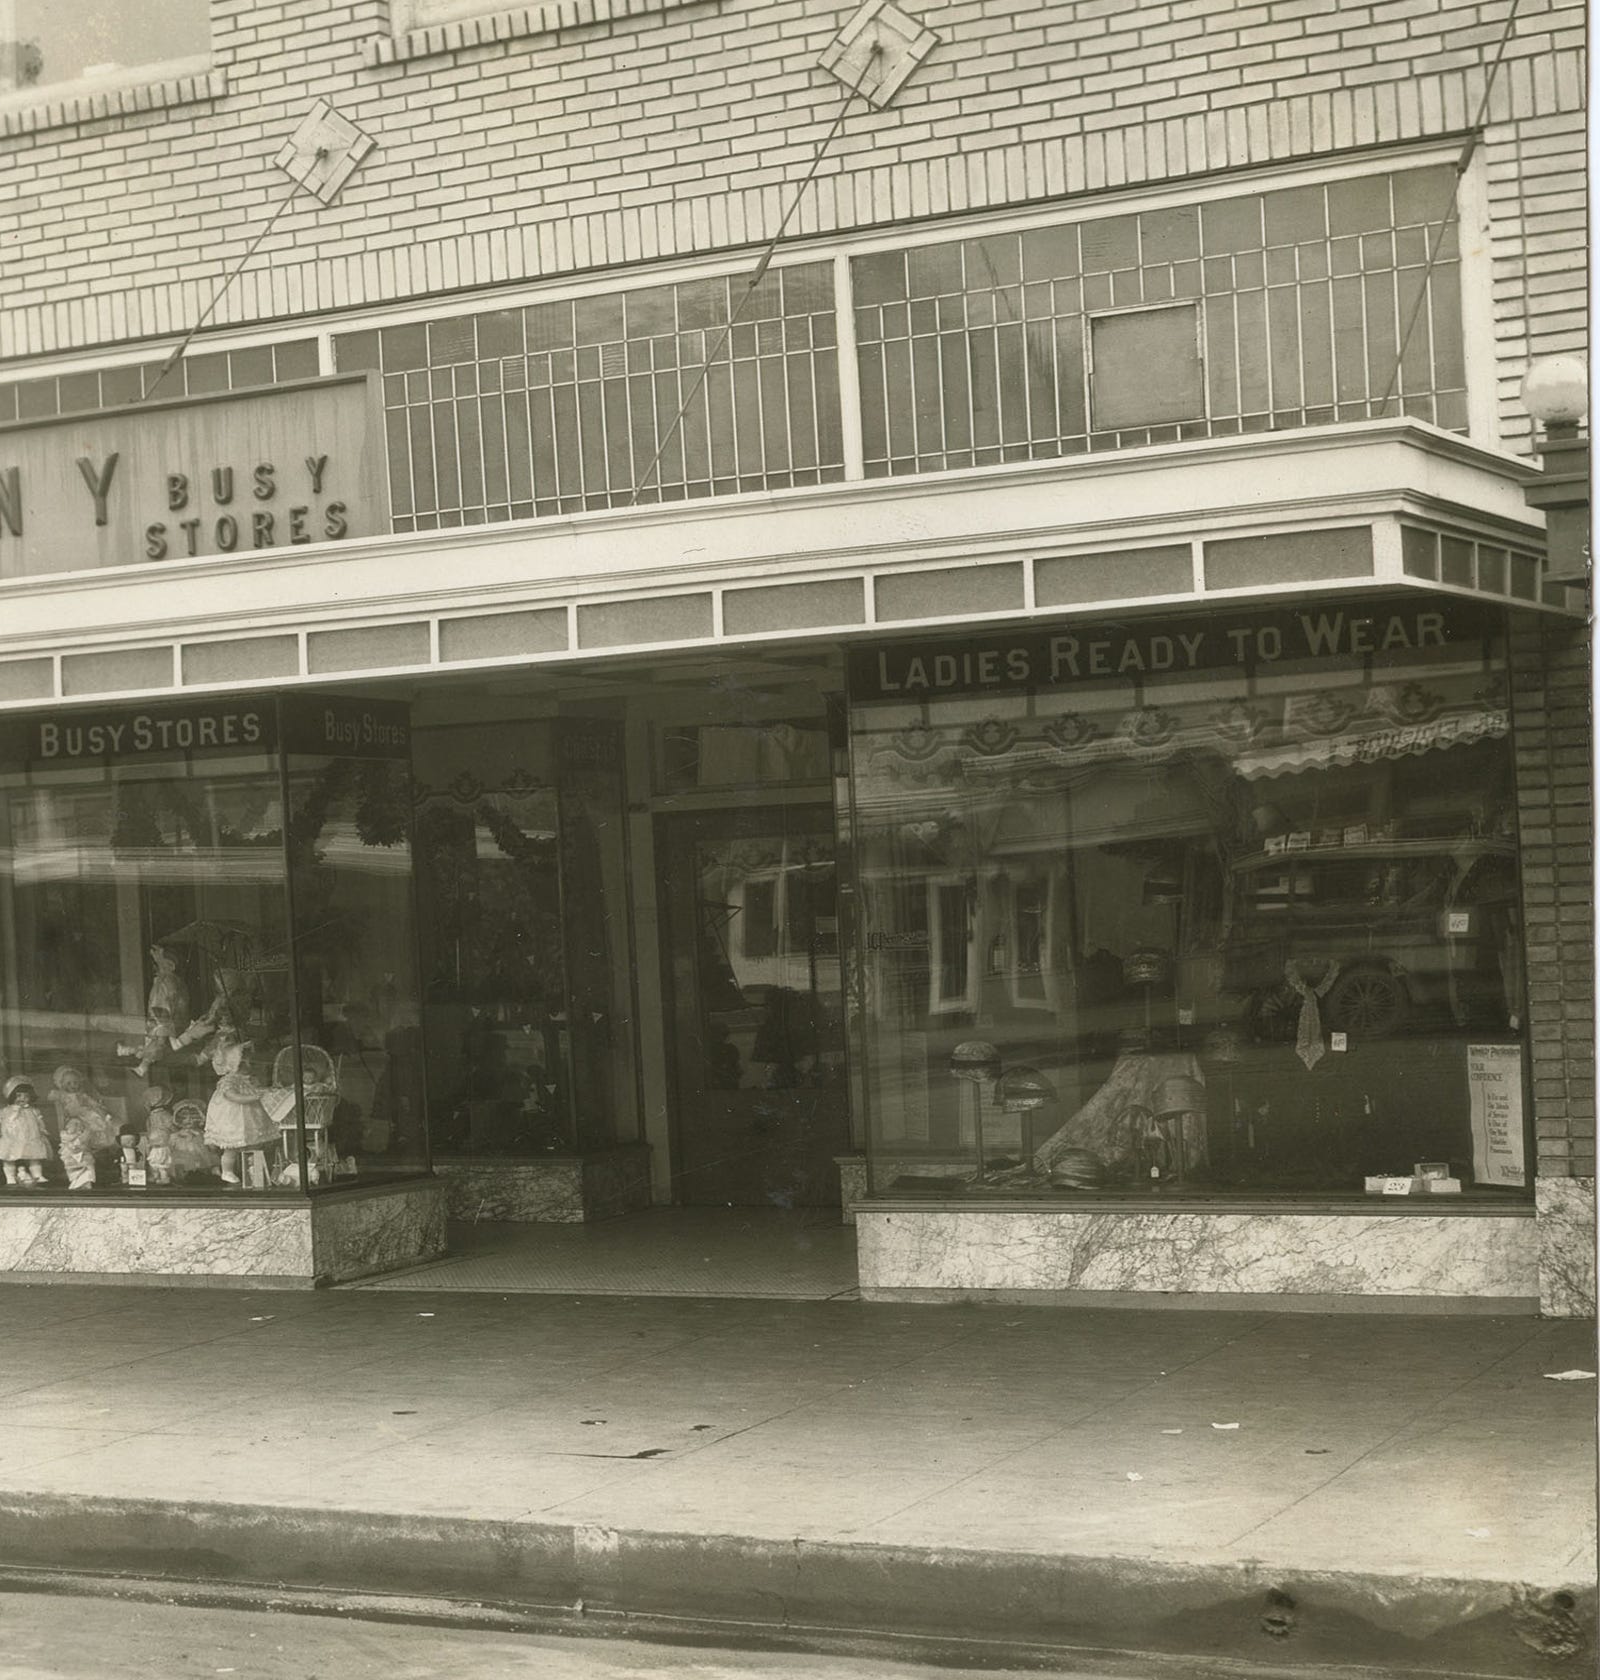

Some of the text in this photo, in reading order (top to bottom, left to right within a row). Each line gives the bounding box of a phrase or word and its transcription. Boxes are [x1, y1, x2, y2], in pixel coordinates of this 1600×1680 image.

[167, 453, 329, 511] BUSY
[145, 501, 350, 561] STORES
[878, 611, 1447, 691] LADIES READY TO WEAR
[40, 713, 261, 757] BUSY STORES
[325, 710, 406, 748] Busy Stores
